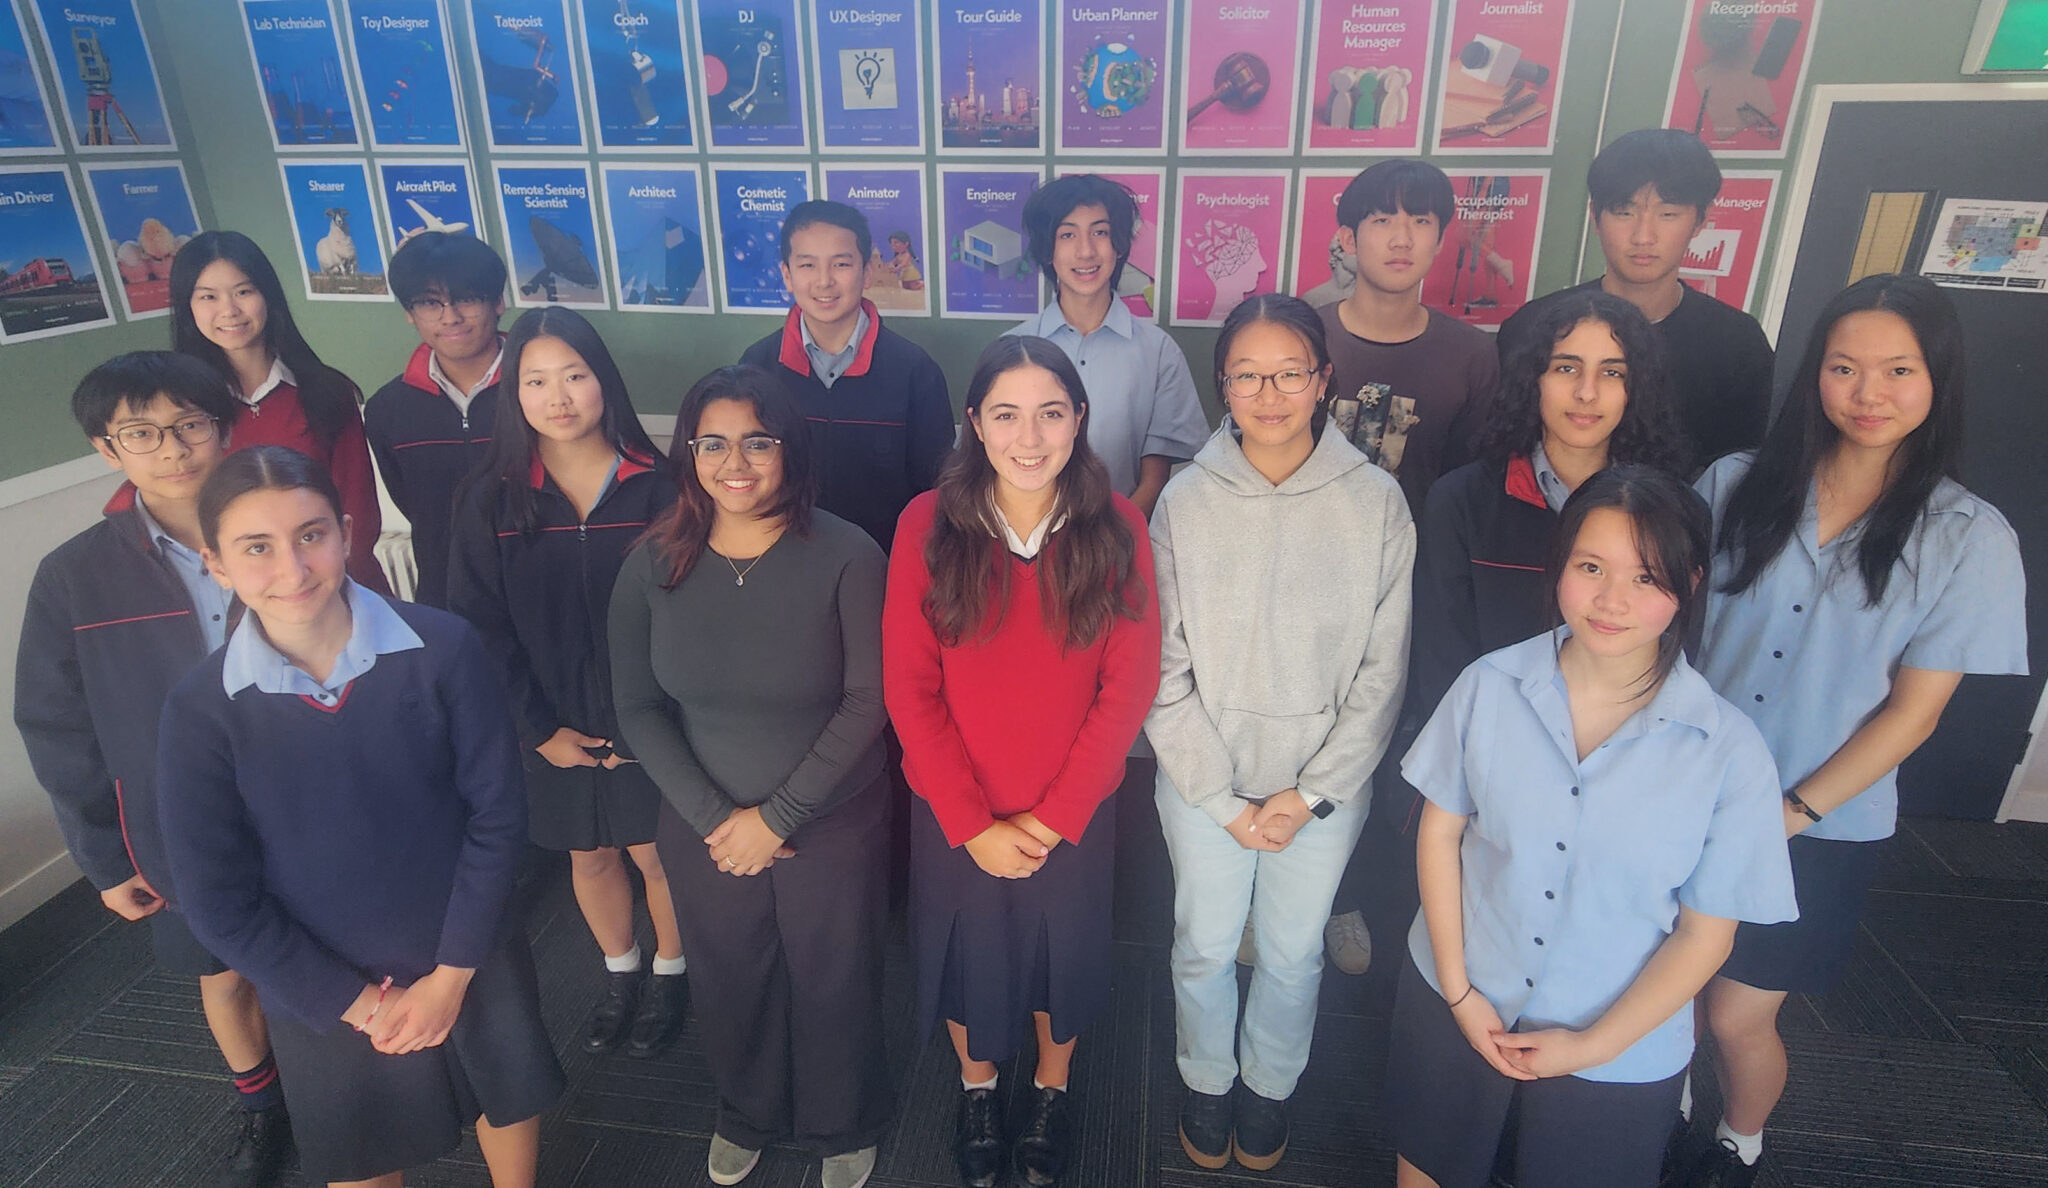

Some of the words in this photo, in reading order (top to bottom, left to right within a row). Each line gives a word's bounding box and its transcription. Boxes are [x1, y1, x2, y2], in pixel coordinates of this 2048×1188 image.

[1072, 7, 1110, 22] Urban
[1111, 7, 1159, 21] Planner
[1218, 6, 1270, 21] Solicitor
[1351, 4, 1400, 18] Human
[1480, 0, 1544, 15] Journalist
[1710, 0, 1799, 18] Receptionist
[64, 8, 117, 27] Surveyor
[253, 17, 272, 31] Lab
[273, 16, 327, 30] Technician
[361, 16, 382, 32] Toy
[382, 16, 430, 32] Designer
[494, 14, 543, 28] Tattooist
[613, 12, 649, 27] Coach
[738, 9, 755, 24] DJ
[829, 10, 849, 24] UX
[850, 9, 902, 26] Designer
[955, 9, 984, 24] Tour
[985, 9, 1022, 23] Guide
[1342, 19, 1406, 34] Resources
[1343, 35, 1402, 51] Manager
[122, 182, 159, 196] Farmer
[308, 179, 345, 193] Shearer
[395, 180, 432, 193] Aircraft
[432, 180, 458, 193] Pilot
[502, 183, 544, 197] Remote
[544, 184, 586, 199] Sensing
[628, 185, 676, 199] Architect
[736, 185, 787, 200] Cosmetic
[847, 186, 900, 200] Animator
[14, 191, 54, 205] Driver
[524, 196, 569, 209] Scientist
[966, 187, 1017, 203] Engineer
[1195, 191, 1270, 209] Psychologist
[740, 199, 786, 212] Chemist
[1456, 206, 1514, 224] Therapist
